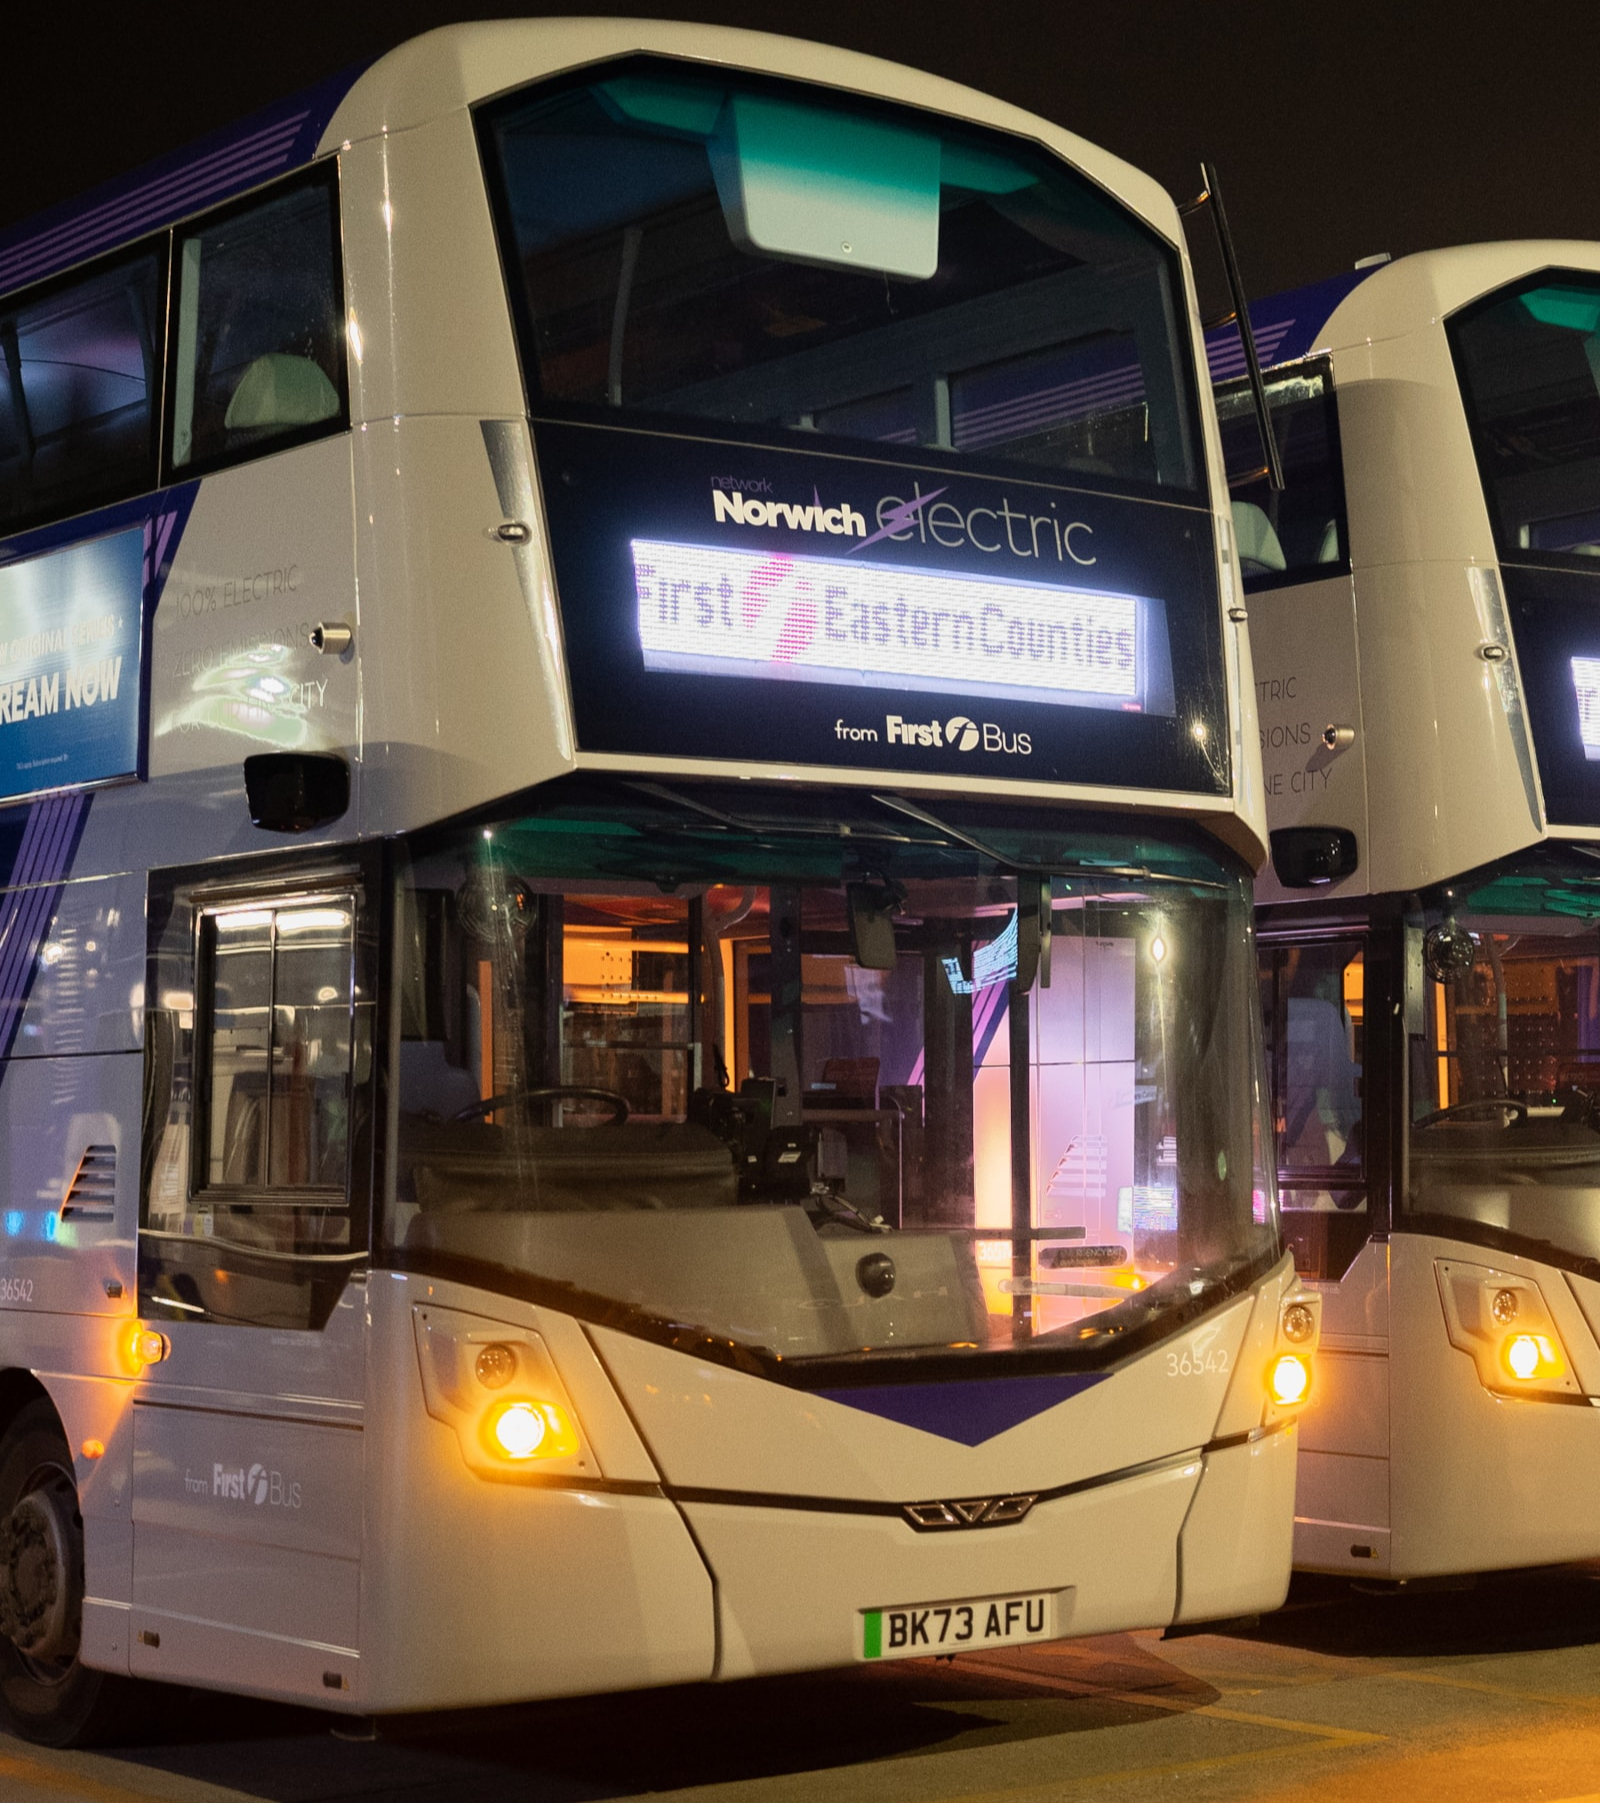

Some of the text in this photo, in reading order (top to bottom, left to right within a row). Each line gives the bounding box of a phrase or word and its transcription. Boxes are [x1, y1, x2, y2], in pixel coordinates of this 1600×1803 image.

[711, 476, 773, 494] network
[713, 481, 1098, 567] Norwich electric
[176, 564, 297, 621] 100% ELECTRIC
[825, 585, 1133, 669] EasternCounties
[0, 656, 122, 725] REAM NOW
[1255, 676, 1297, 701] TRIC
[834, 715, 1032, 755] from First Bus
[1291, 768, 1332, 793] CITY
[0, 1277, 33, 1302] 36542
[1166, 1349, 1229, 1377] 36542
[184, 1462, 302, 1508] from First Bus
[889, 1599, 1044, 1648] BK73 AFU
